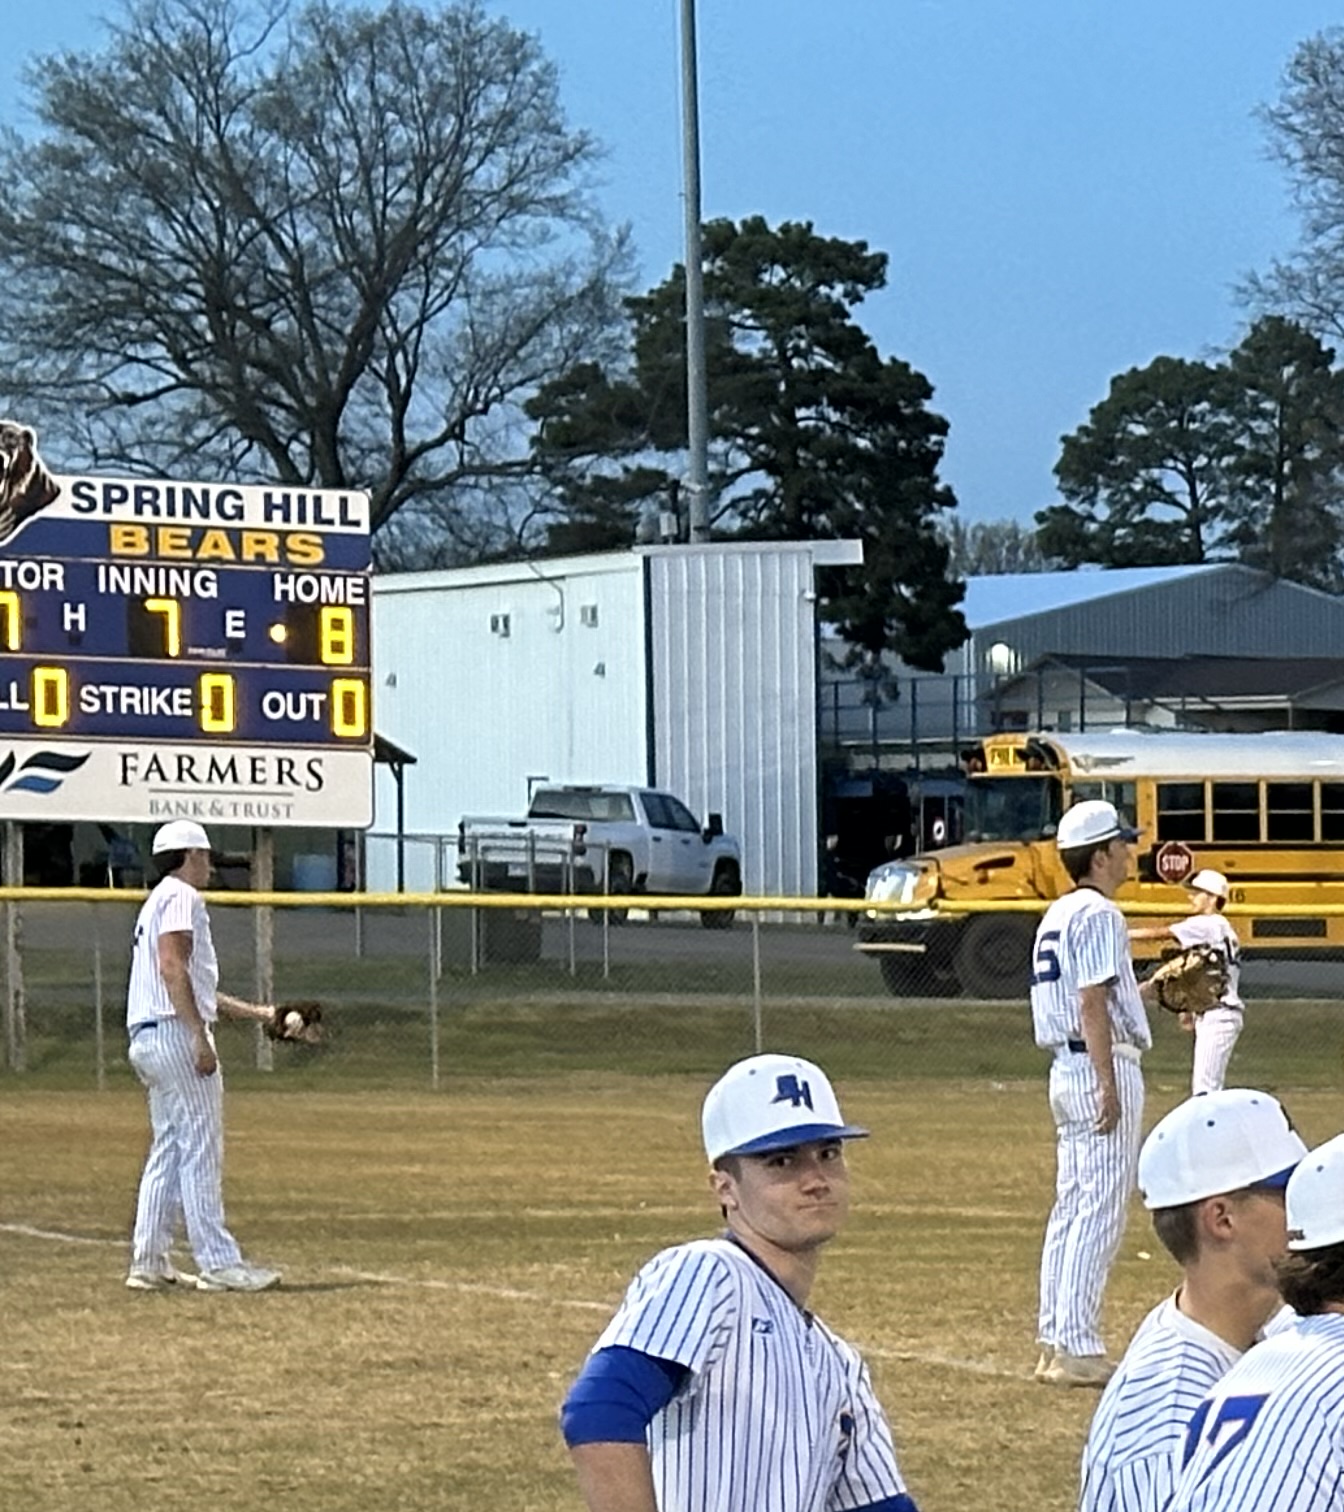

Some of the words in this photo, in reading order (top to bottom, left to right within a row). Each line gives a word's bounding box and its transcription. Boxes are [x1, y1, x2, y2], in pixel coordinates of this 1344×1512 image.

[71, 481, 245, 521] SPRING
[263, 491, 362, 527] HILL
[110, 524, 325, 565] BEARS
[99, 568, 218, 598] INNING
[274, 573, 365, 605] HOME
[63, 602, 86, 632] H
[144, 598, 180, 657] 7
[225, 610, 246, 638] E
[320, 606, 354, 664] 8
[33, 667, 68, 727] 0
[80, 685, 193, 716] STRIKE
[200, 673, 235, 733] 0
[262, 692, 328, 721] OUT
[332, 679, 366, 737] 0
[119, 752, 325, 791] FARMERS
[150, 799, 206, 816] BANK
[208, 799, 224, 817] &
[230, 801, 294, 819] TRUST
[1162, 854, 1189, 871] STOP
[1029, 930, 1061, 983] 5
